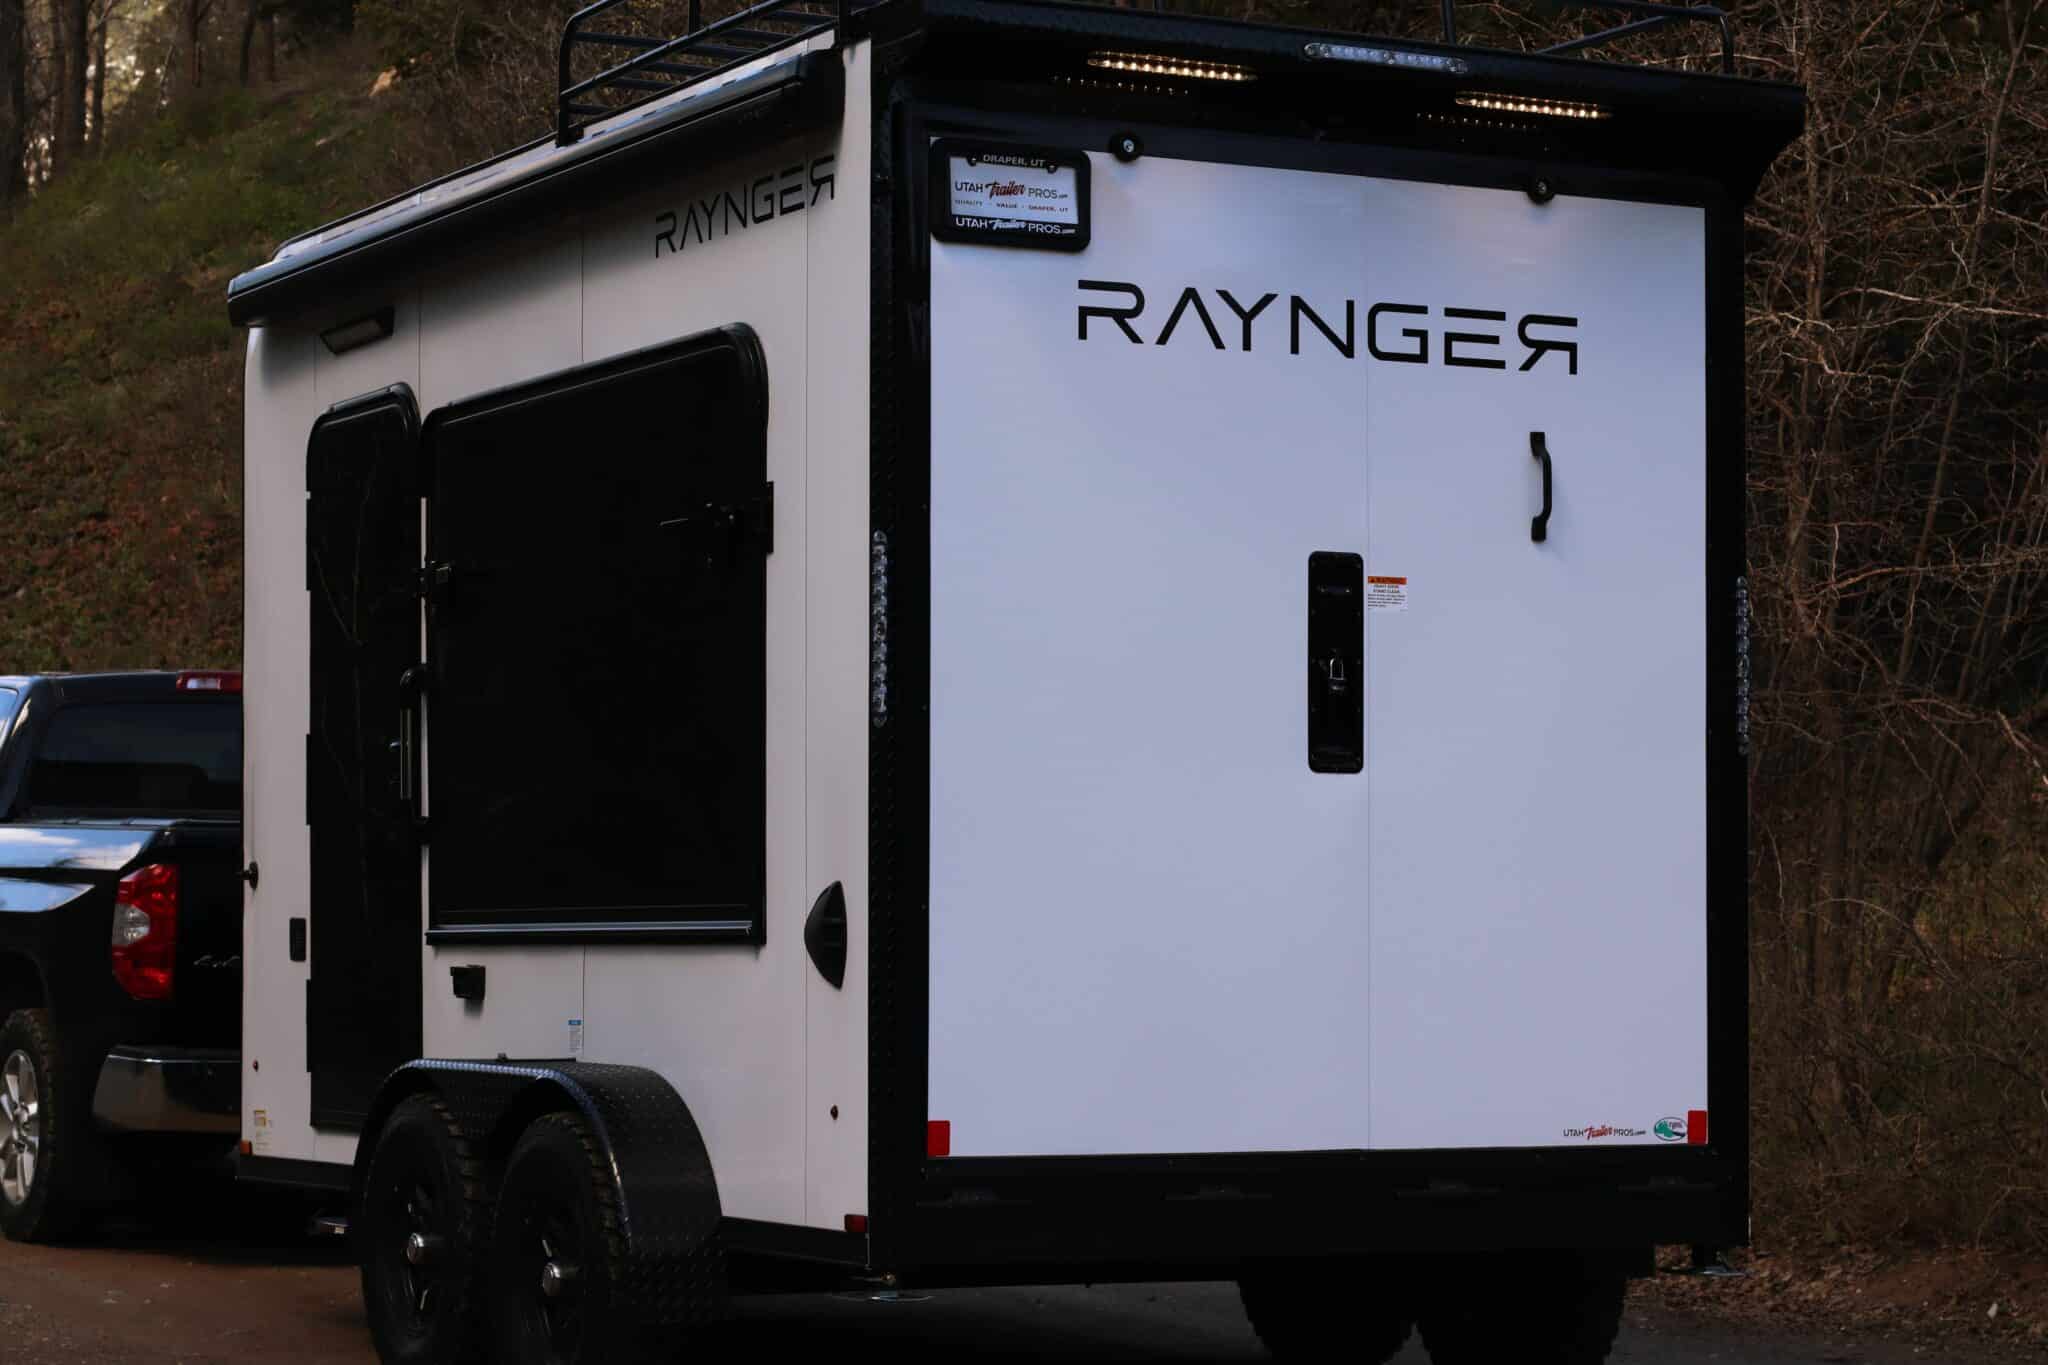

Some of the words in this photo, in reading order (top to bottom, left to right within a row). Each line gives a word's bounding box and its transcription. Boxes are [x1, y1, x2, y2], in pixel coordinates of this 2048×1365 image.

[1030, 159, 1045, 167] UT
[954, 181, 983, 193] UTAH
[985, 180, 1025, 199] Trailer
[655, 154, 835, 258] RAYNGER
[956, 217, 988, 229] UTAH
[1078, 279, 1578, 375] RAYNGER
[1563, 1128, 1584, 1137] UTAH
